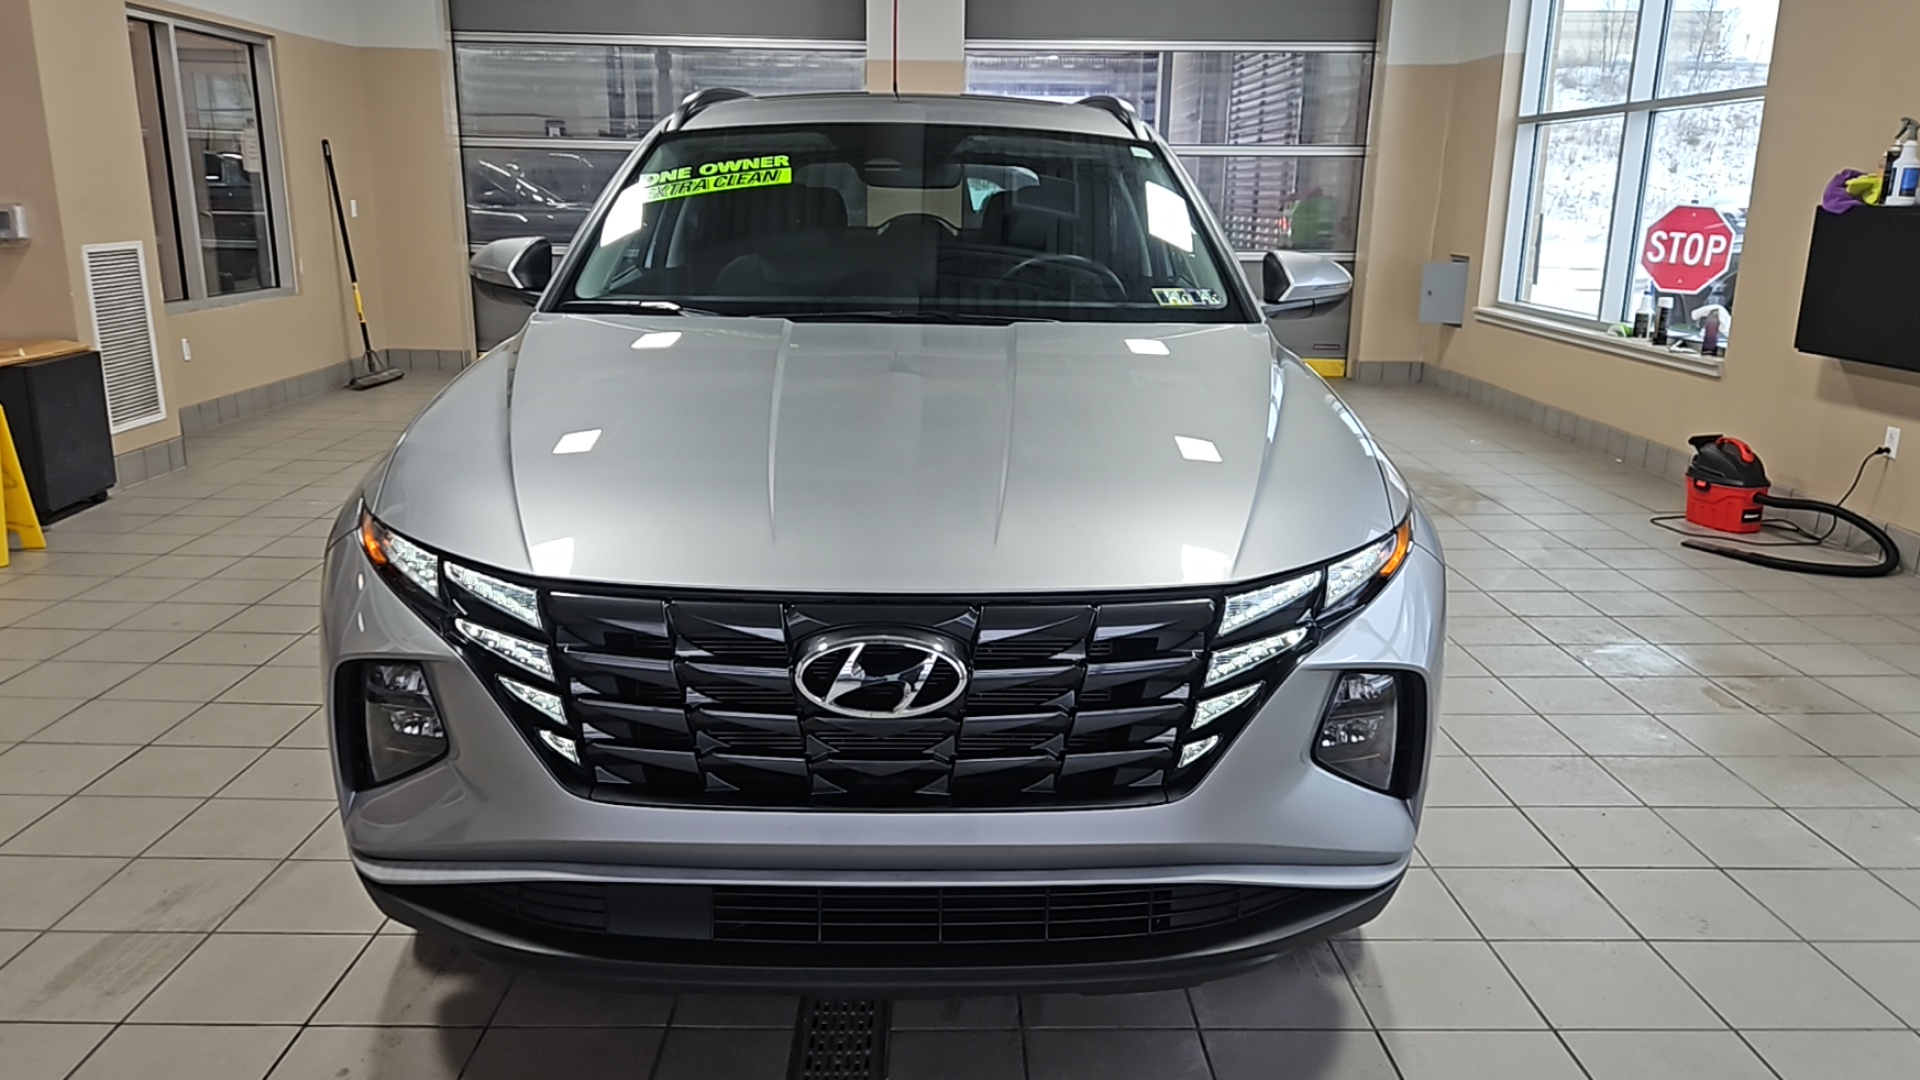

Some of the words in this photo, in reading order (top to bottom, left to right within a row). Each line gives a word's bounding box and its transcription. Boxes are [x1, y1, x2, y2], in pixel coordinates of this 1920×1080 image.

[641, 167, 692, 186] ONE
[699, 155, 790, 175] OWNER
[713, 170, 781, 189] CLEAN
[1646, 230, 1727, 266] STOP
